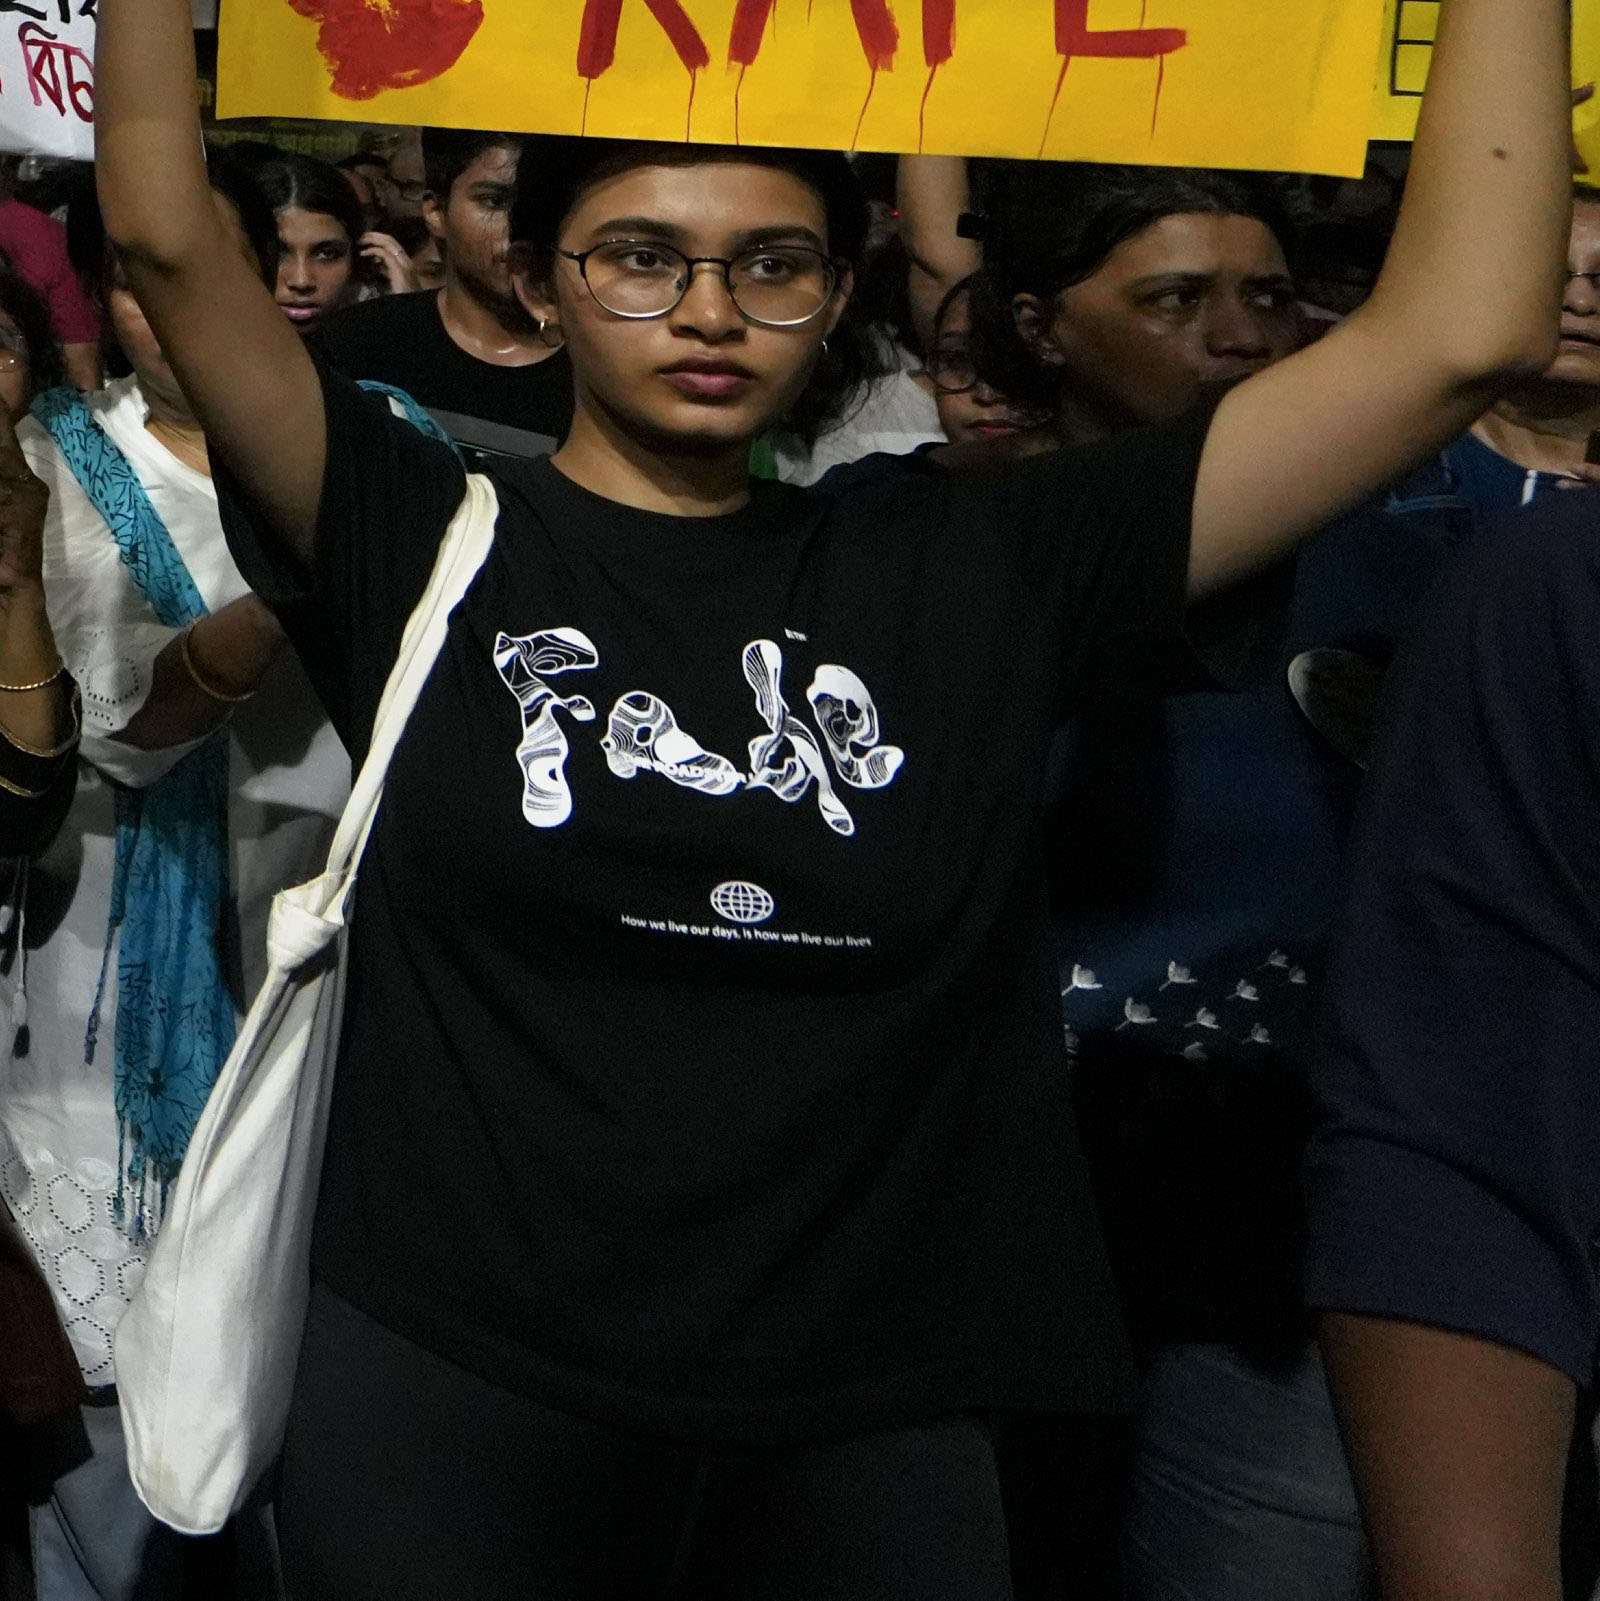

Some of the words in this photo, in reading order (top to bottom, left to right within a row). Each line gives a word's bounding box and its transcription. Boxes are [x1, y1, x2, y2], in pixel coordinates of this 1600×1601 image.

[18, 20, 95, 123] বিচ
[621, 914, 646, 928] How
[649, 919, 665, 930] we
[668, 920, 688, 934] live
[690, 925, 710, 936] our
[755, 928, 779, 941] how
[782, 932, 799, 943] we
[801, 932, 822, 945] live
